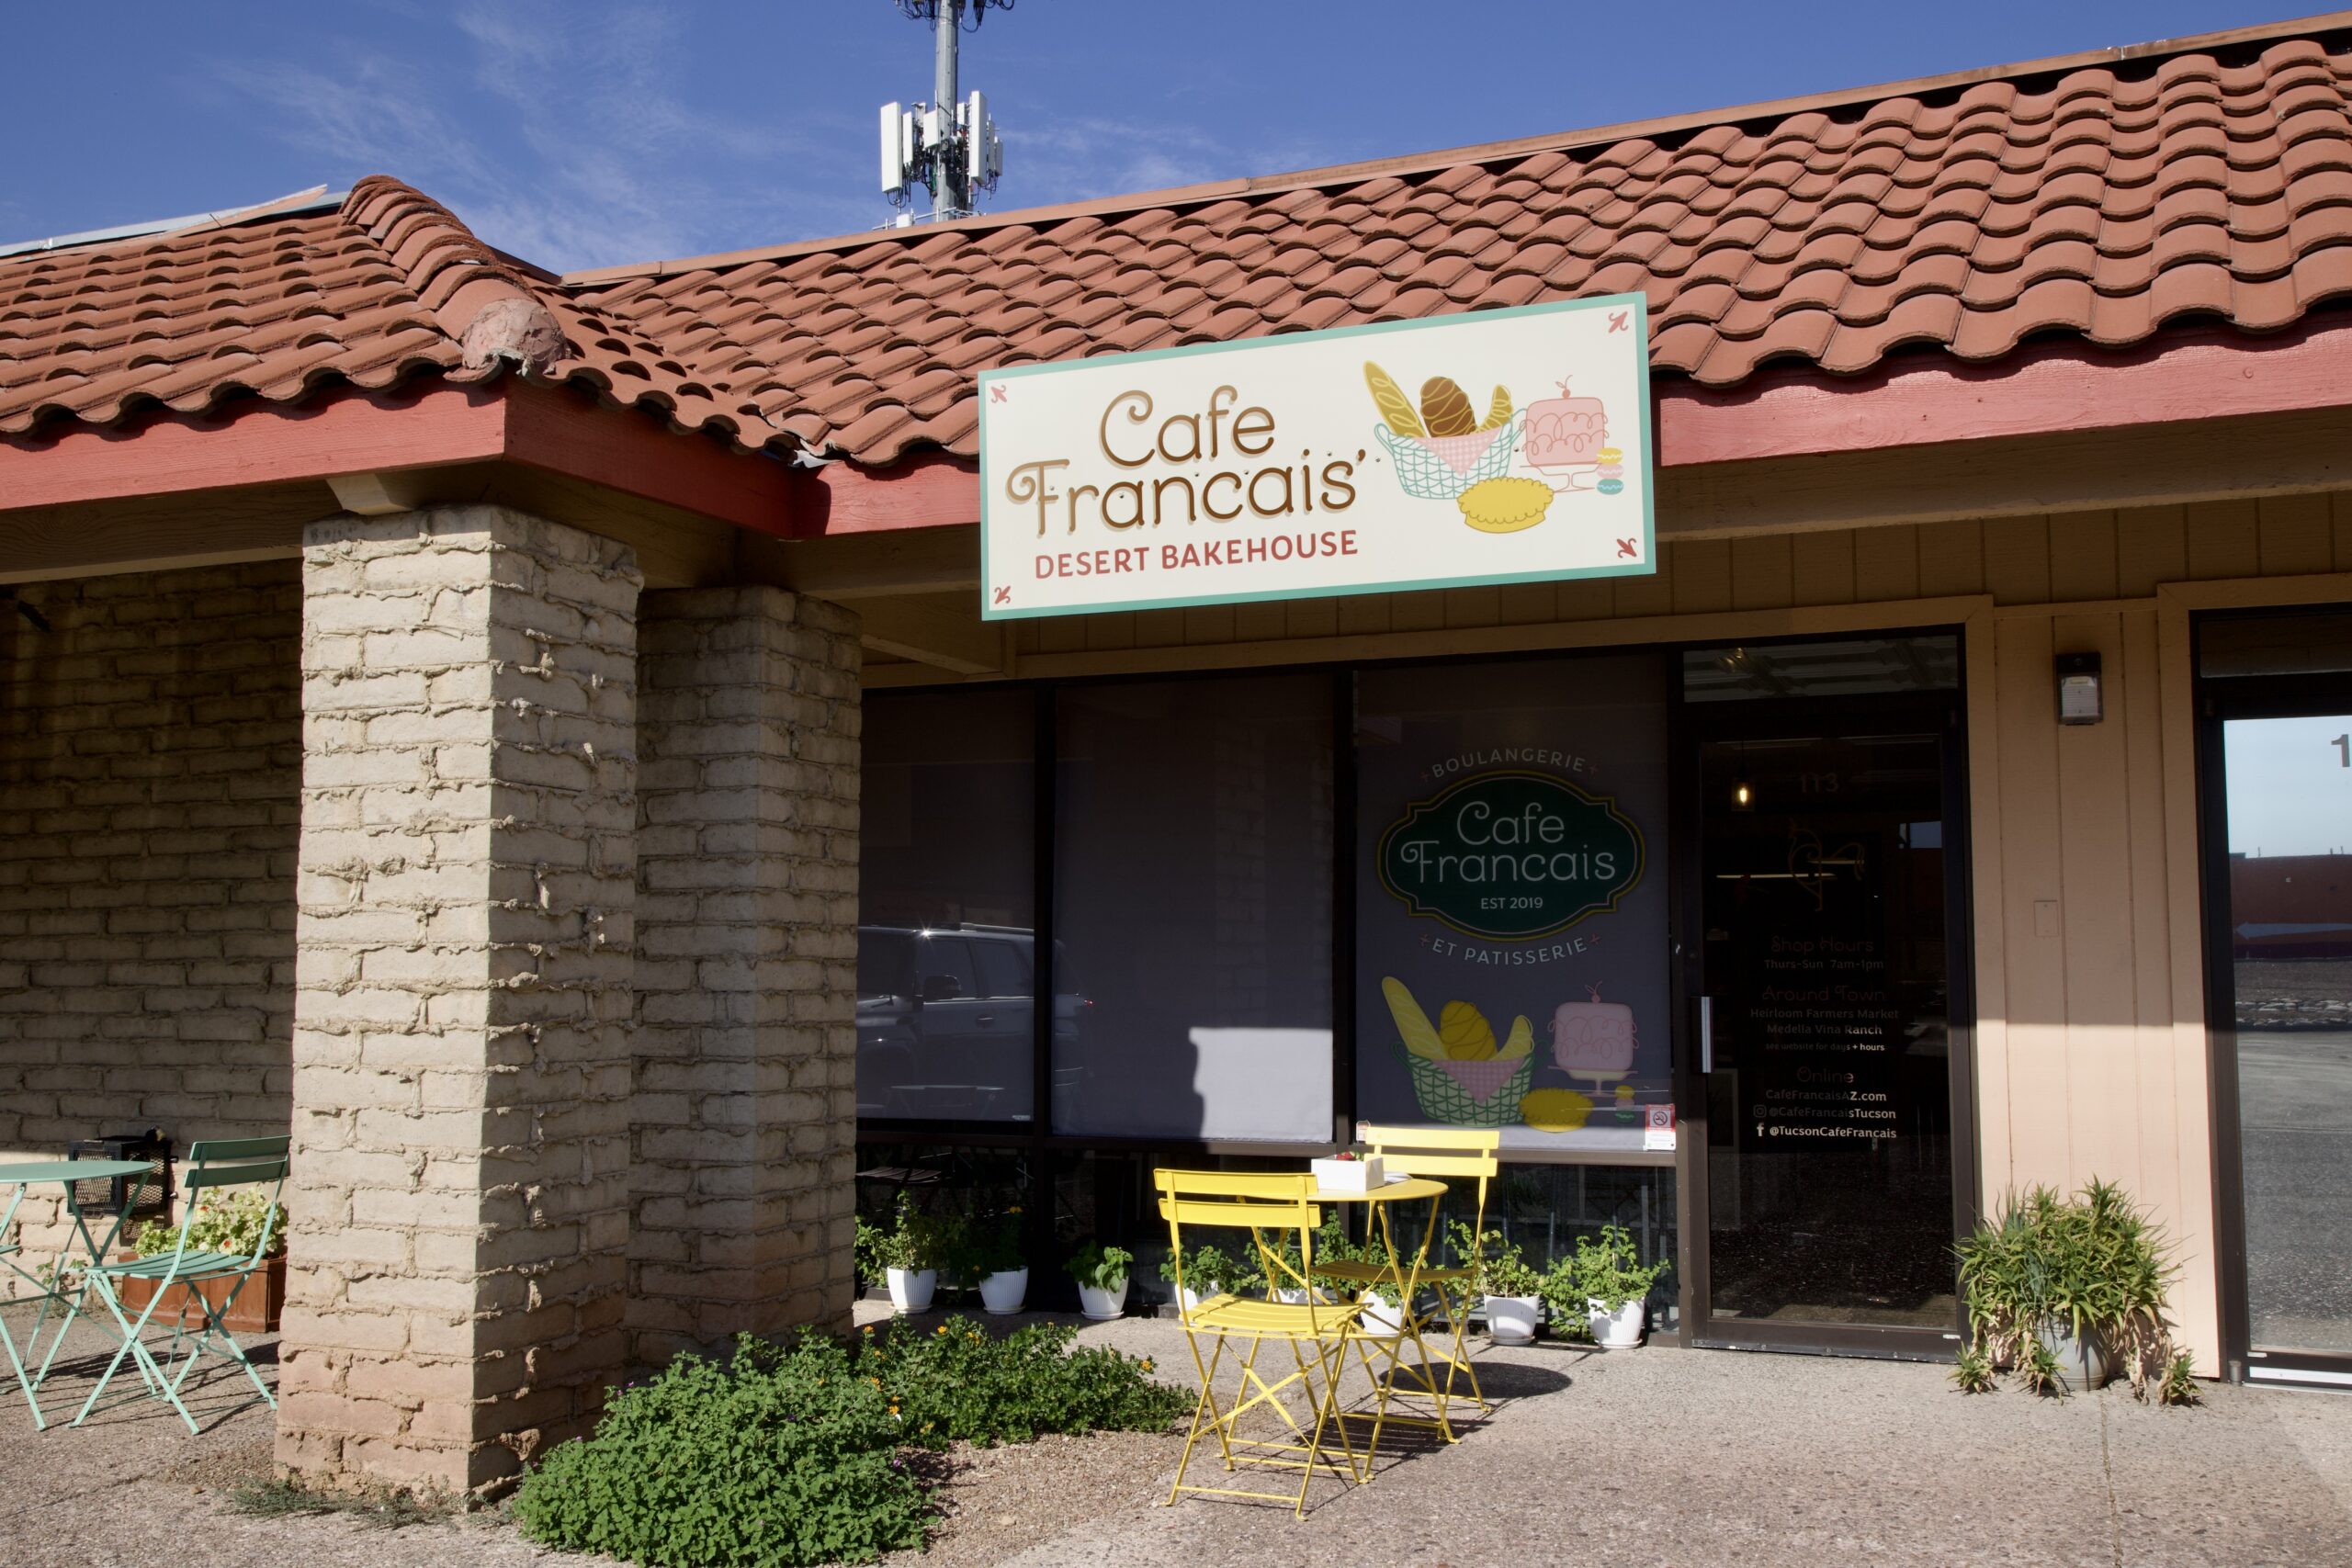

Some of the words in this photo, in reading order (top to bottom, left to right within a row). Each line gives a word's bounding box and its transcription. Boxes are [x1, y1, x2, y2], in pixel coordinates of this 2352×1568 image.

[1099, 384, 1276, 468] Cafe
[1035, 547, 1150, 580] DESERT
[1160, 529, 1359, 570] BAKEHOUSE
[1431, 747, 1587, 779] BOULANGERIE
[1456, 800, 1566, 846] Cafe
[1399, 840, 1616, 884] Francais
[1480, 897, 1507, 909] EST
[1510, 897, 1544, 909] 2019
[1431, 937, 1458, 956] ET
[1464, 936, 1588, 965] PATISSERIE
[1770, 934, 1815, 955] Shop
[1819, 933, 1875, 953] Hours
[1763, 958, 1824, 970] Thurs-Sun
[1830, 958, 1885, 972] 7am-1pm
[1761, 985, 1830, 1002] Around
[1833, 985, 1886, 1002] Town
[1749, 1008, 1804, 1019] Heirloom
[1806, 1009, 1854, 1020] Farmers
[1858, 1009, 1899, 1020] Market
[1845, 1024, 1883, 1035] Ranch
[1829, 1043, 1850, 1052] days
[1860, 1043, 1885, 1051] hours
[1796, 1066, 1855, 1084] Online
[1765, 1089, 1887, 1101] CafeFrancaisAZ.com
[1769, 1106, 1897, 1119] @CafeFrancaisTucson
[1769, 1125, 1897, 1139] @TucsonCafeFrancais
